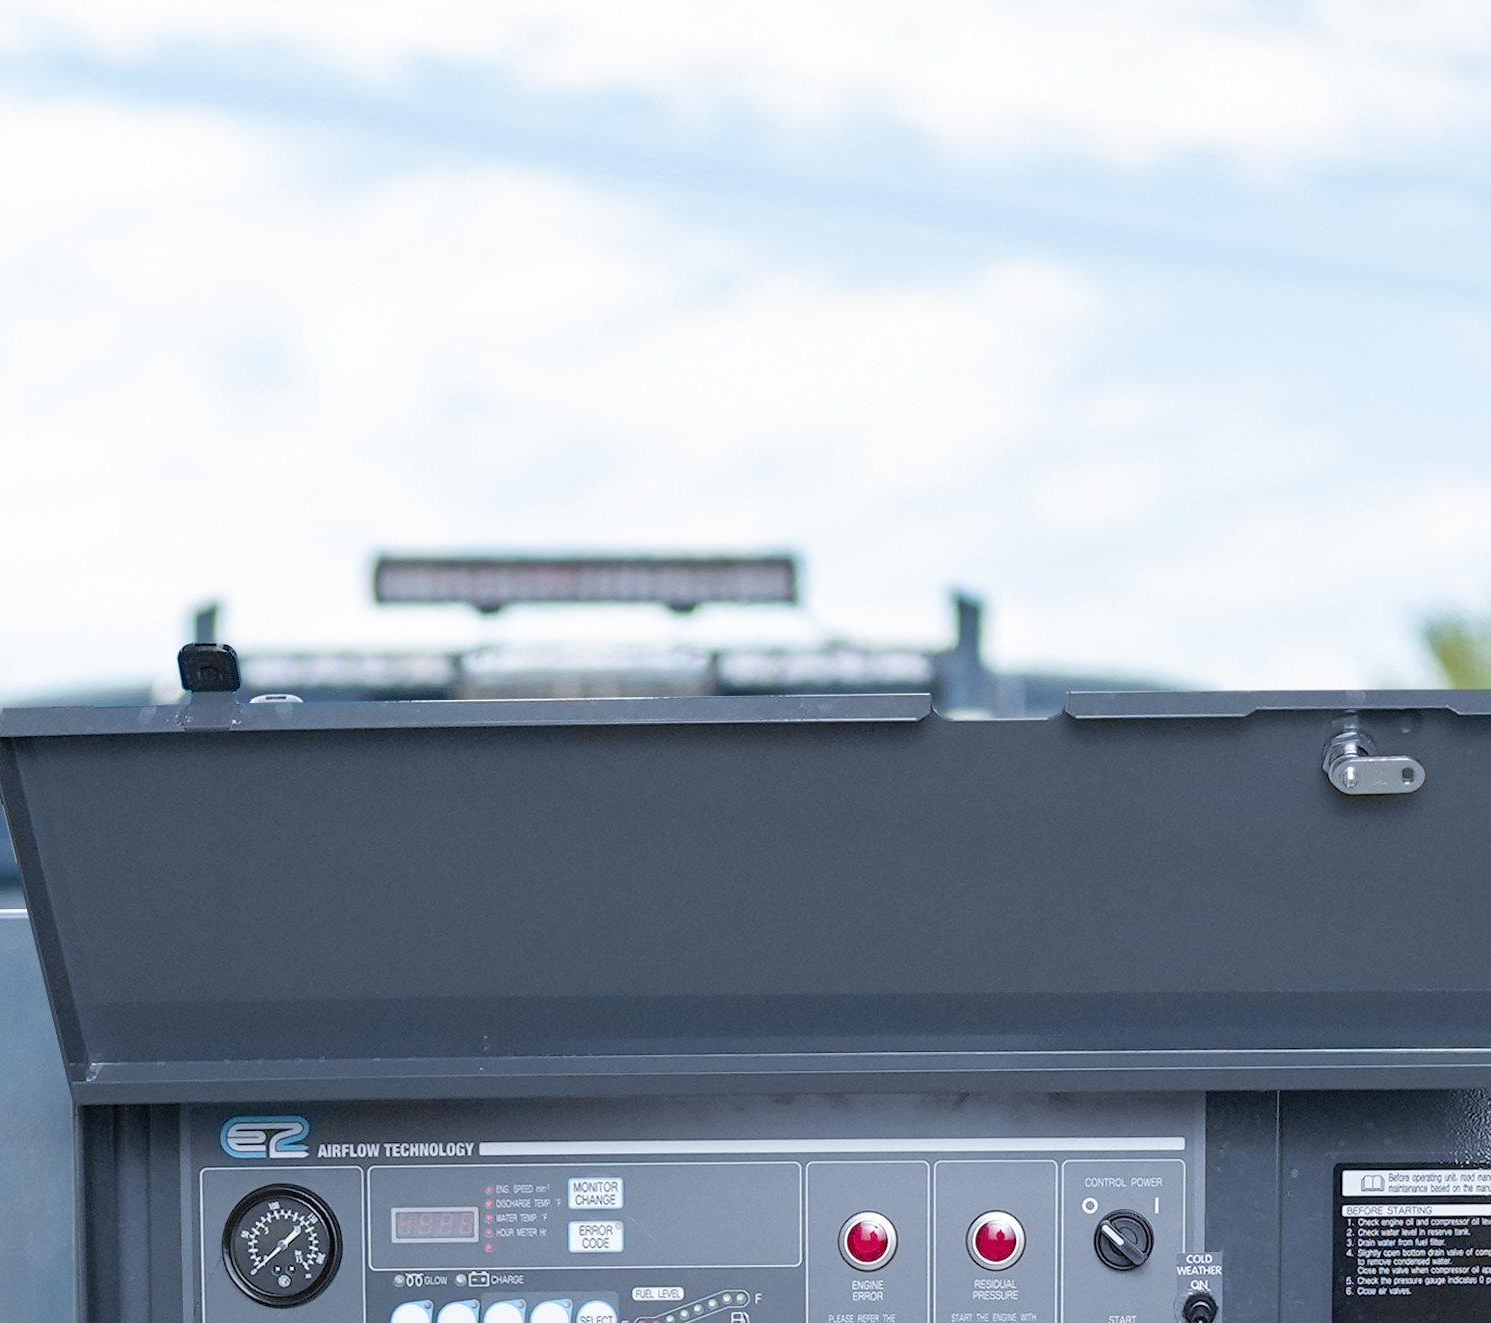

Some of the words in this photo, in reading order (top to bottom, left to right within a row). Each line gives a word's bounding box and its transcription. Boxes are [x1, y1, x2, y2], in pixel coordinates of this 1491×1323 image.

[317, 1142, 380, 1158] AIRFLOW
[384, 1141, 474, 1156] TECHNOLOGY
[1085, 1177, 1127, 1187] CONTROL
[1131, 1176, 1162, 1187] POWER
[574, 1182, 618, 1193] MONITOR
[575, 1194, 616, 1205] CHANGE
[1346, 1207, 1382, 1215] BEFORE
[1387, 1206, 1432, 1215] STARTING
[578, 1225, 614, 1236] ERROR
[582, 1238, 609, 1248] CODE
[1186, 1254, 1212, 1265] COLD
[1177, 1265, 1222, 1276] WEATHER
[421, 1274, 447, 1286] GLOW
[488, 1273, 524, 1286] CHARGE
[974, 1279, 1017, 1290] RESIDUAL
[1190, 1279, 1211, 1291] ON
[852, 1280, 884, 1291] ENGINE
[635, 1290, 653, 1299] FUEL
[658, 1289, 681, 1298] LEVEL
[755, 1294, 762, 1304] F
[852, 1290, 883, 1301] ERROR
[973, 1289, 1018, 1300] PRESSURE
[829, 1313, 854, 1323] PLEASE
[882, 1314, 895, 1322] THE
[951, 1312, 972, 1322] START
[976, 1312, 989, 1323] THE
[993, 1312, 1017, 1323] ENGINE
